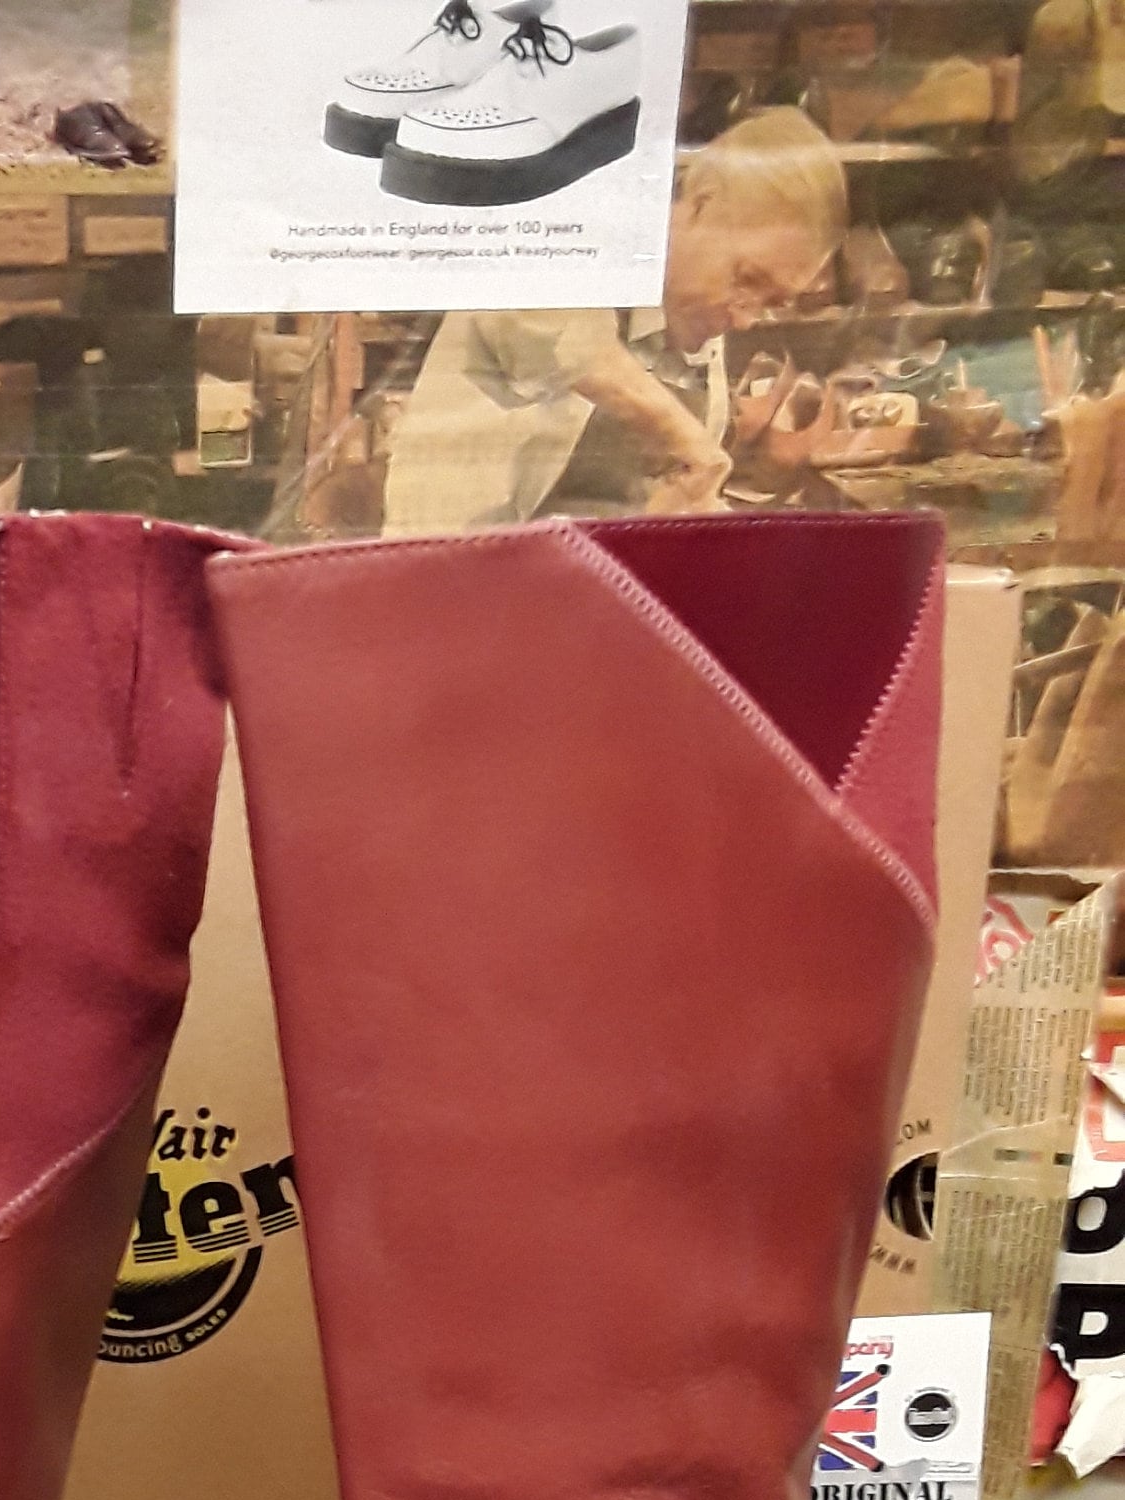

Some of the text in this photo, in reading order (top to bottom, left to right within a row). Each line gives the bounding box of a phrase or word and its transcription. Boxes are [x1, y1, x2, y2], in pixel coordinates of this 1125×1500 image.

[389, 222, 448, 238] England
[453, 221, 472, 235] for
[477, 224, 509, 235] over
[516, 221, 541, 234] 100
[545, 222, 584, 237] years
[98, 1333, 184, 1359] ouncing
